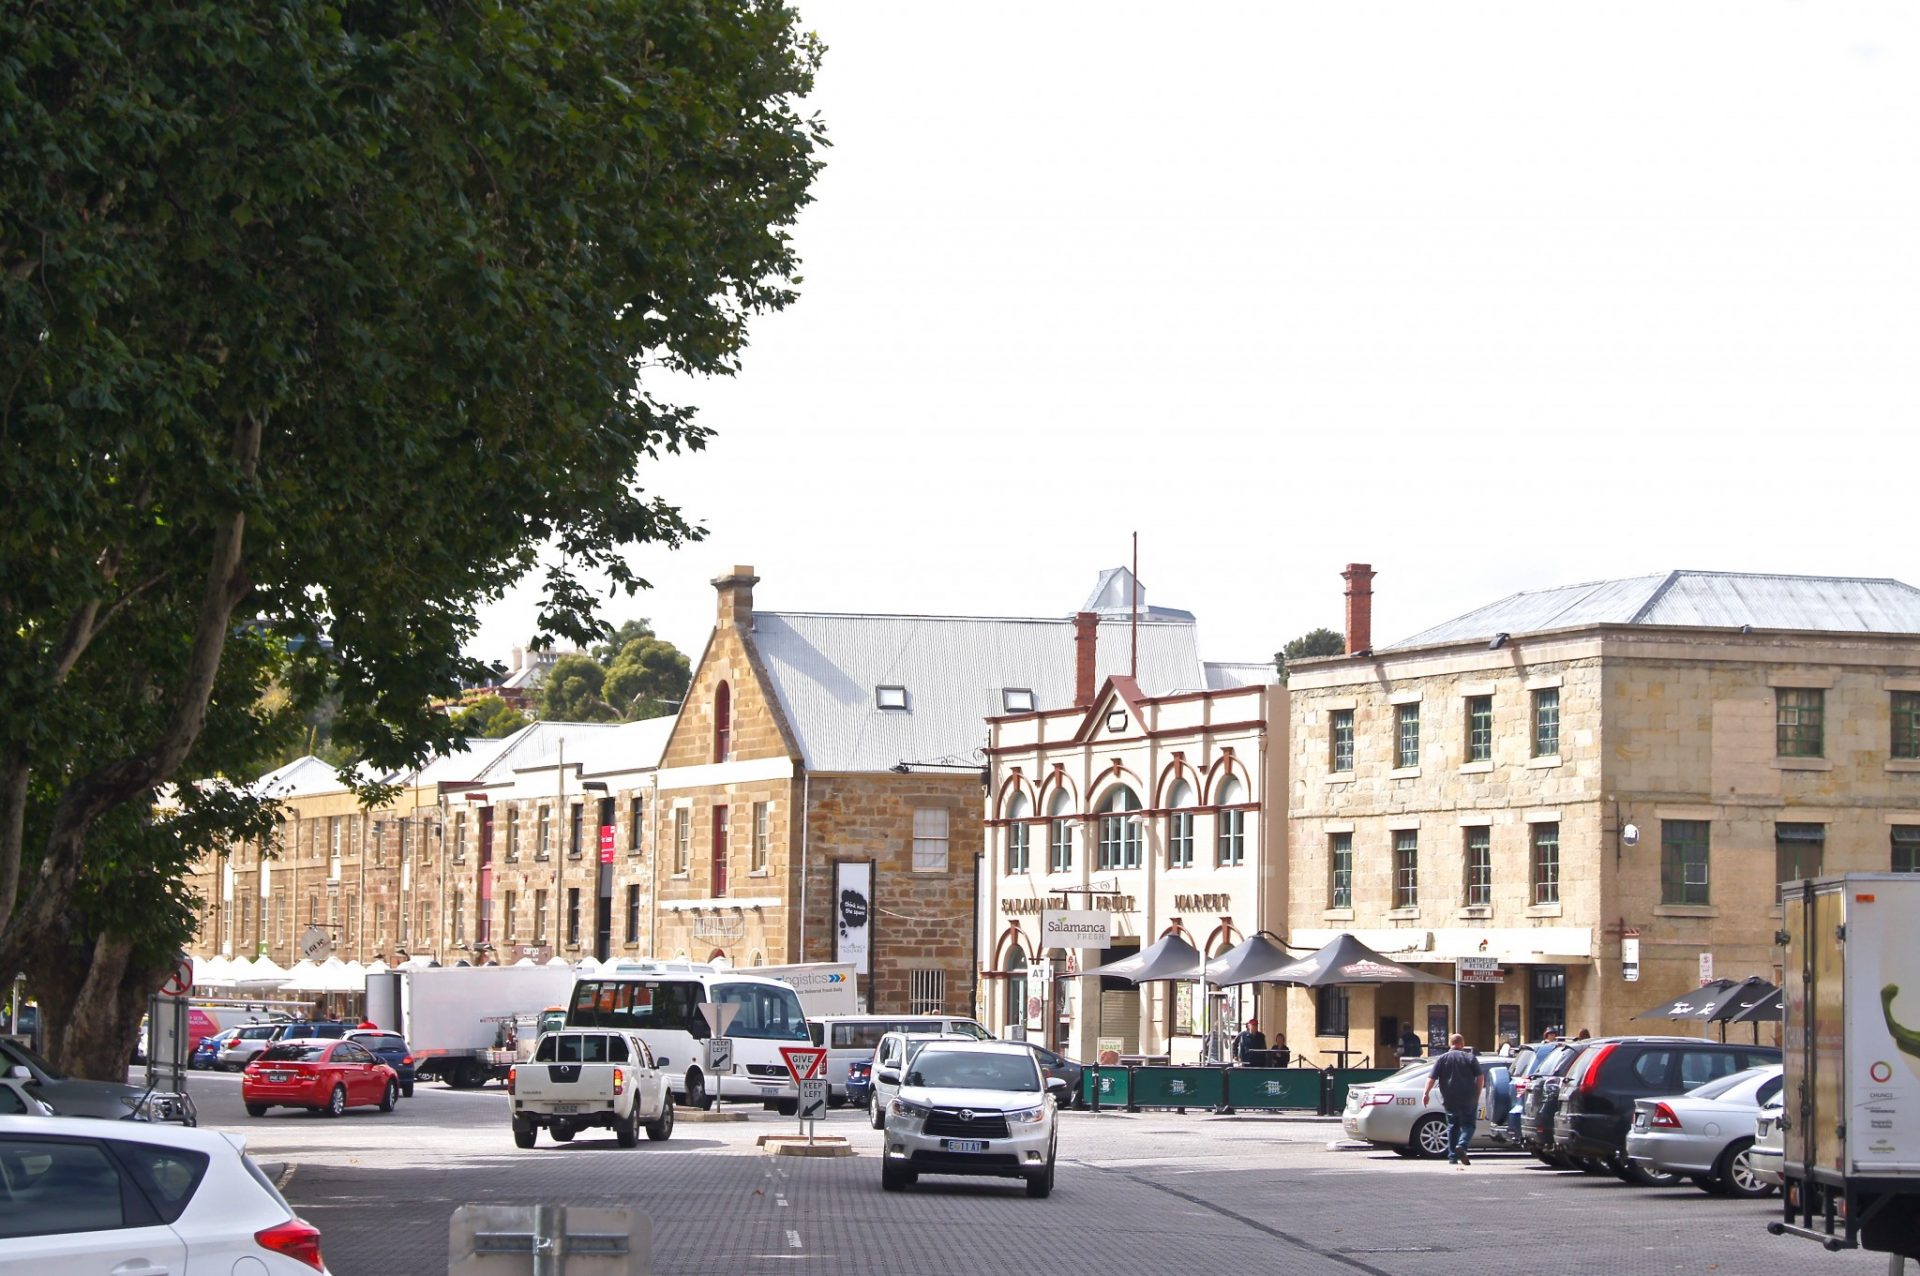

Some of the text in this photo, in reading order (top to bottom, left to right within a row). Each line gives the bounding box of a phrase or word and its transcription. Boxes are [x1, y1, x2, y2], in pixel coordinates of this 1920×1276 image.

[1001, 894, 1230, 911] SALAMANC FRUIT MARKET
[1048, 921, 1106, 933] Salamanca
[782, 973, 828, 988] logistics
[792, 1055, 814, 1063] GIVE
